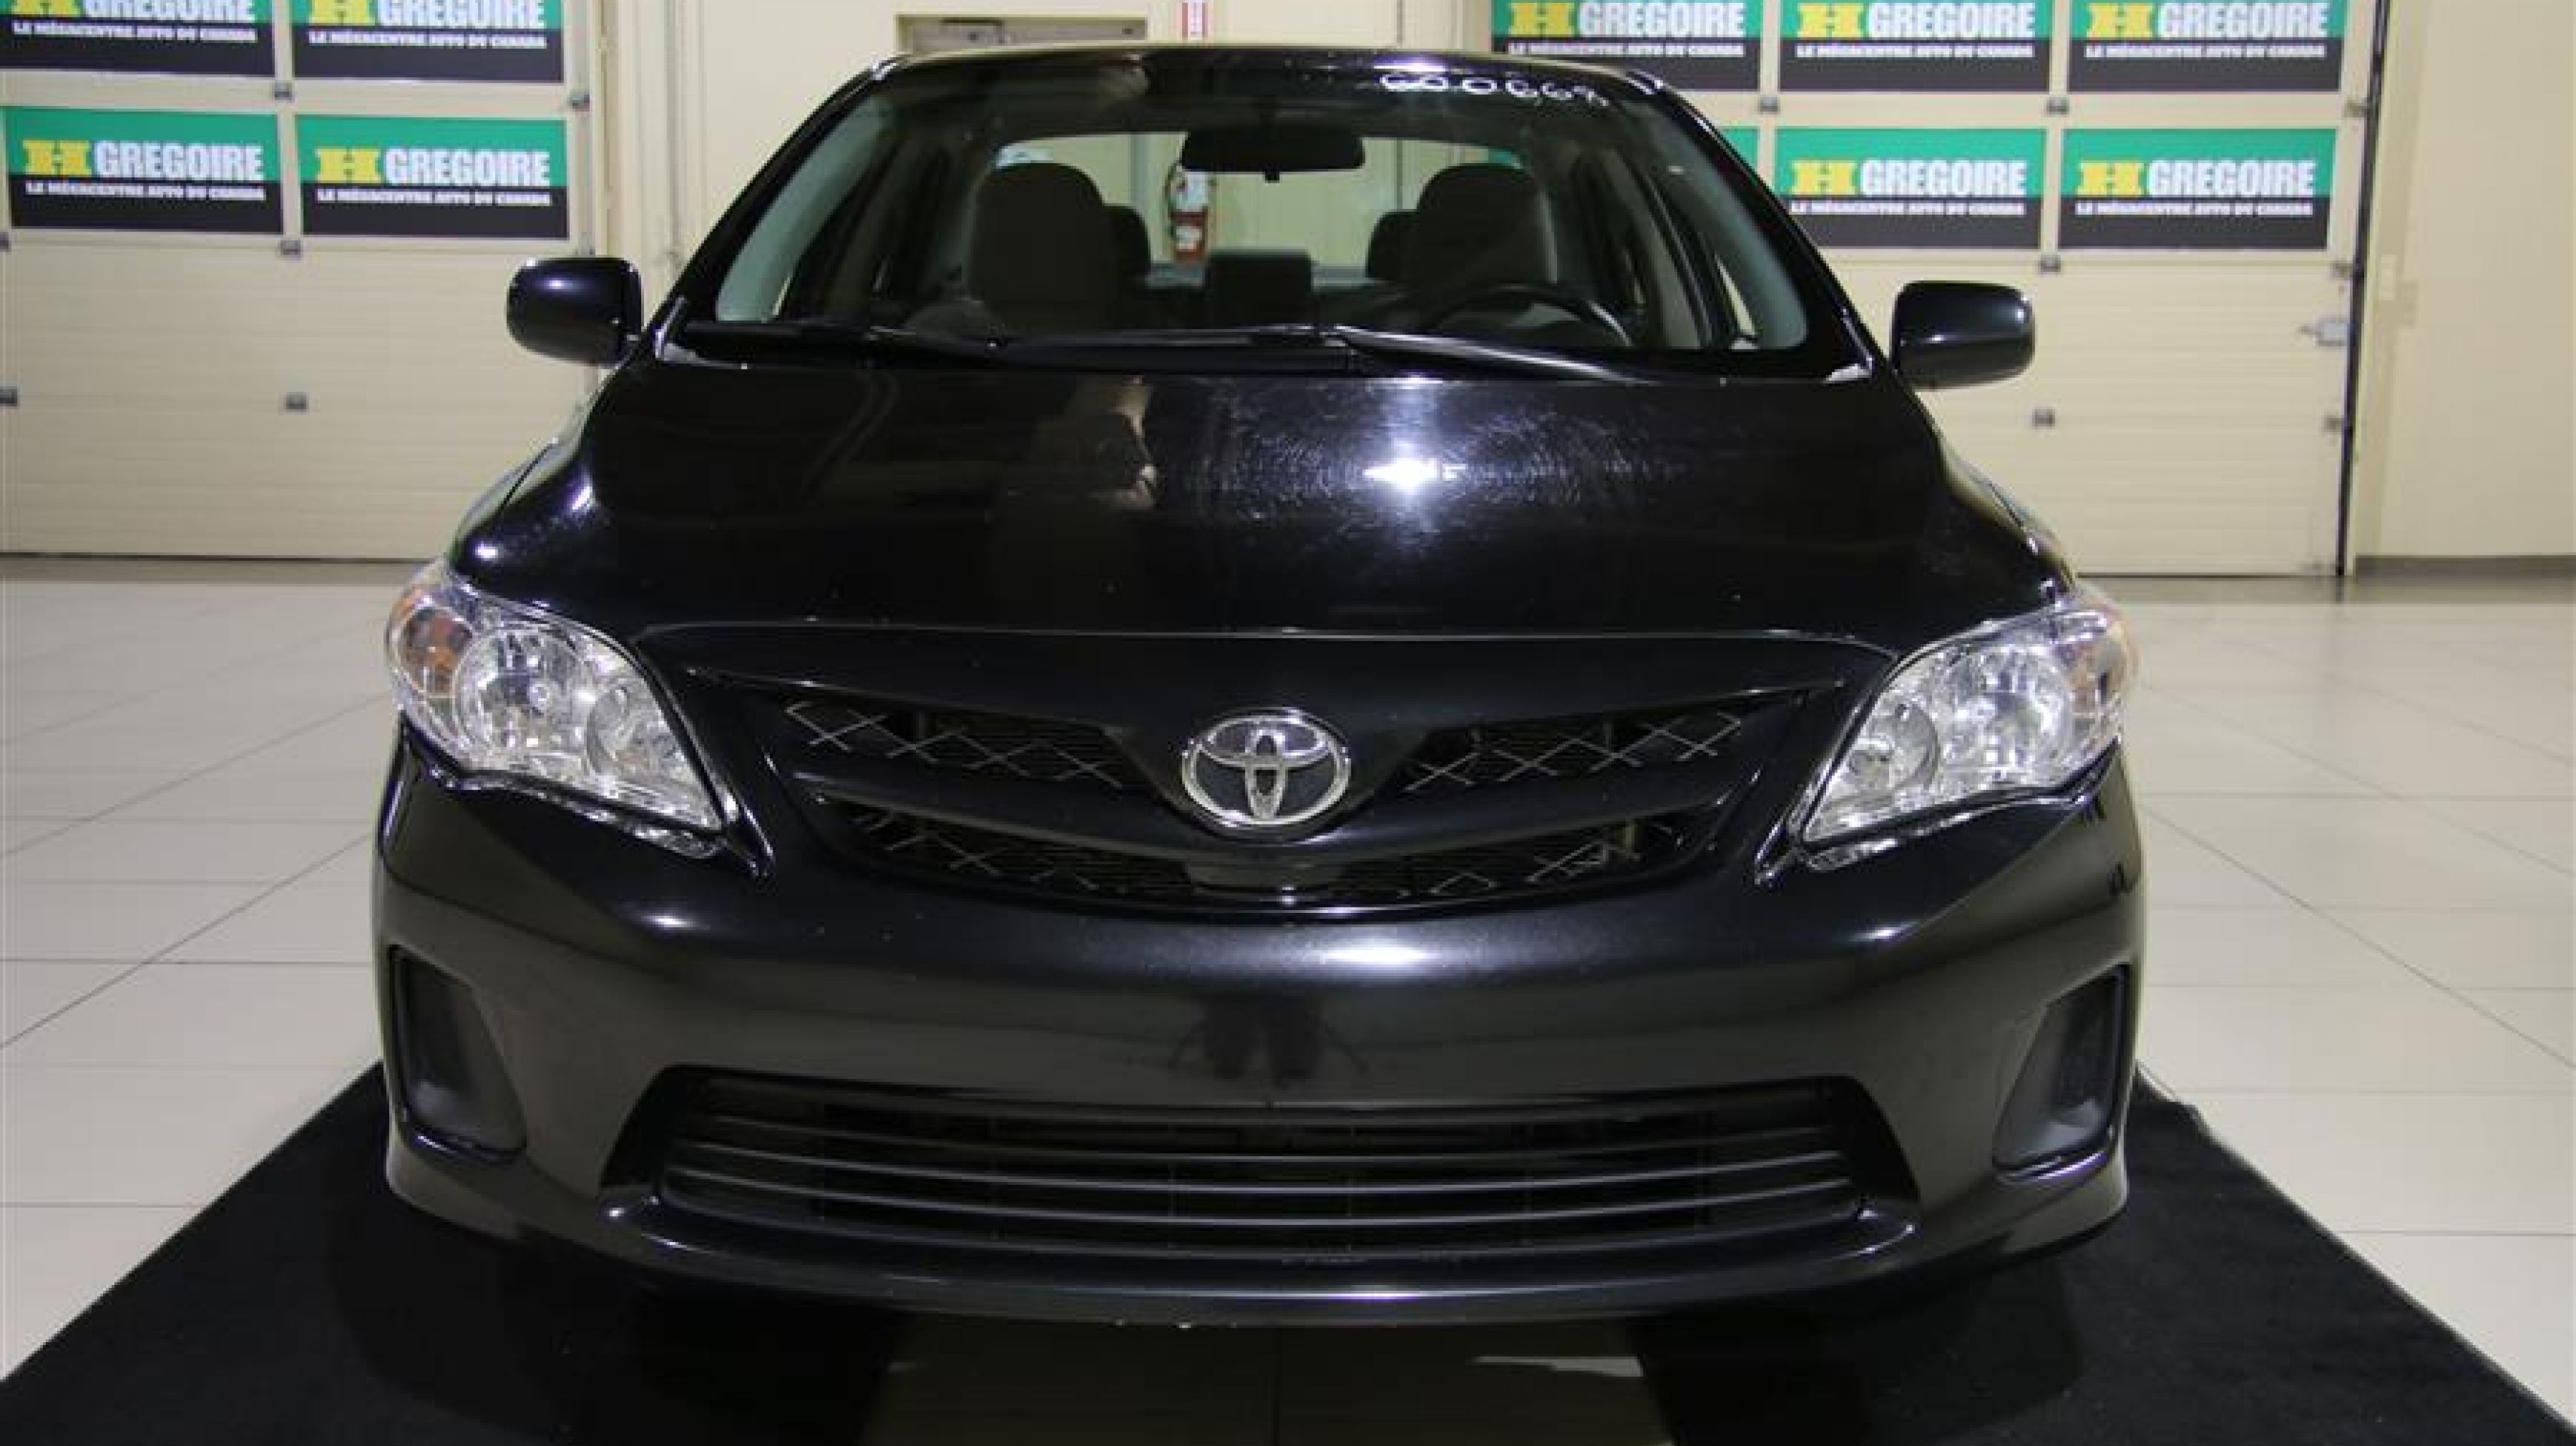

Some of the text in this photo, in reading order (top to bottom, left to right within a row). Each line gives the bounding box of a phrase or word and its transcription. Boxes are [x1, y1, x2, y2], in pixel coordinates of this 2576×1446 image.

[378, 0, 546, 29] GREGOIRE
[1580, 2, 1746, 37] GREGOIRE
[1868, 2, 2035, 40] GREGOIRE
[2157, 2, 2328, 40] GREGOIRE
[95, 141, 264, 181] GREGOIRE
[383, 149, 549, 186] GREGOIRE
[1861, 160, 2027, 197] GREGOIRE
[2147, 160, 2315, 197] GREGOIRE
